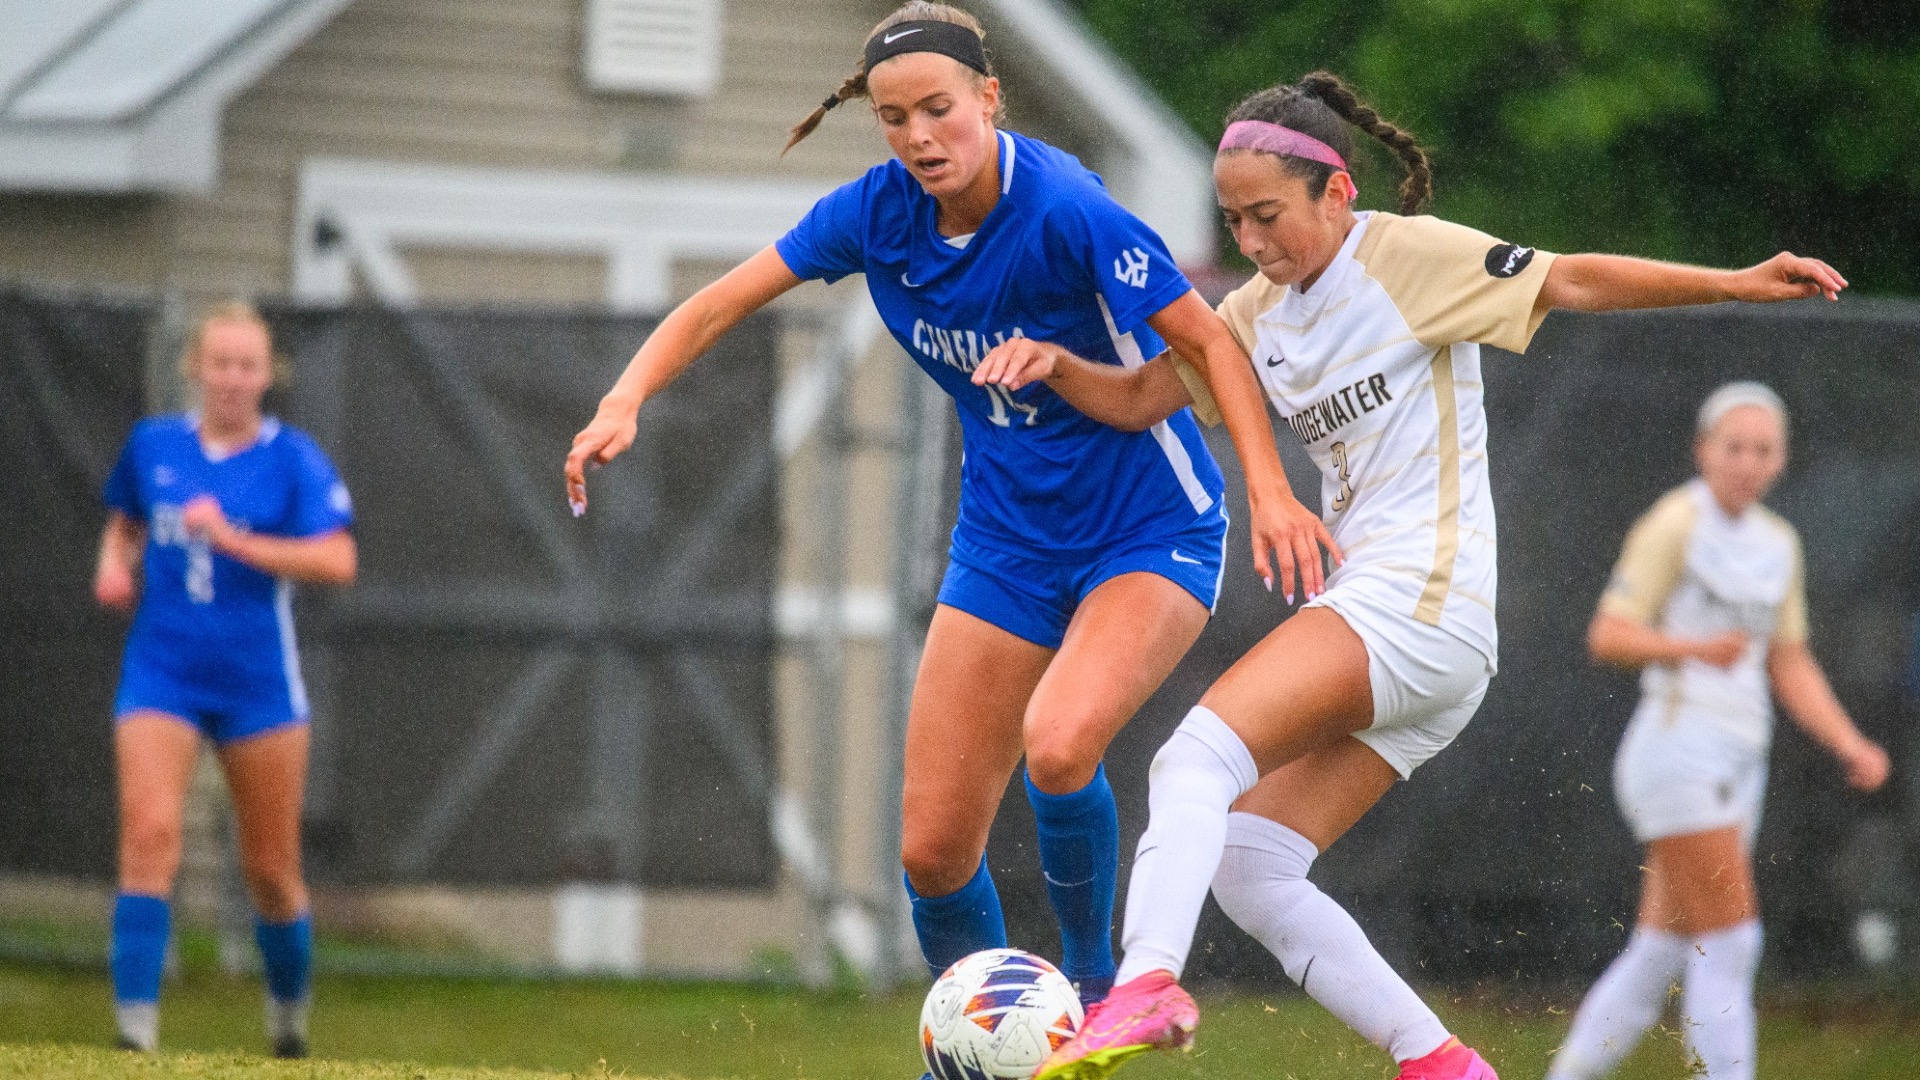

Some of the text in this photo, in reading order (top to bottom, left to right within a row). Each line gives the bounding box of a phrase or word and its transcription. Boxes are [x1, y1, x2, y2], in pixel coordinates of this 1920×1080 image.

[913, 318, 1024, 374] GENER
[1283, 372, 1393, 445] IDGEWATER
[1330, 441, 1353, 512] 3
